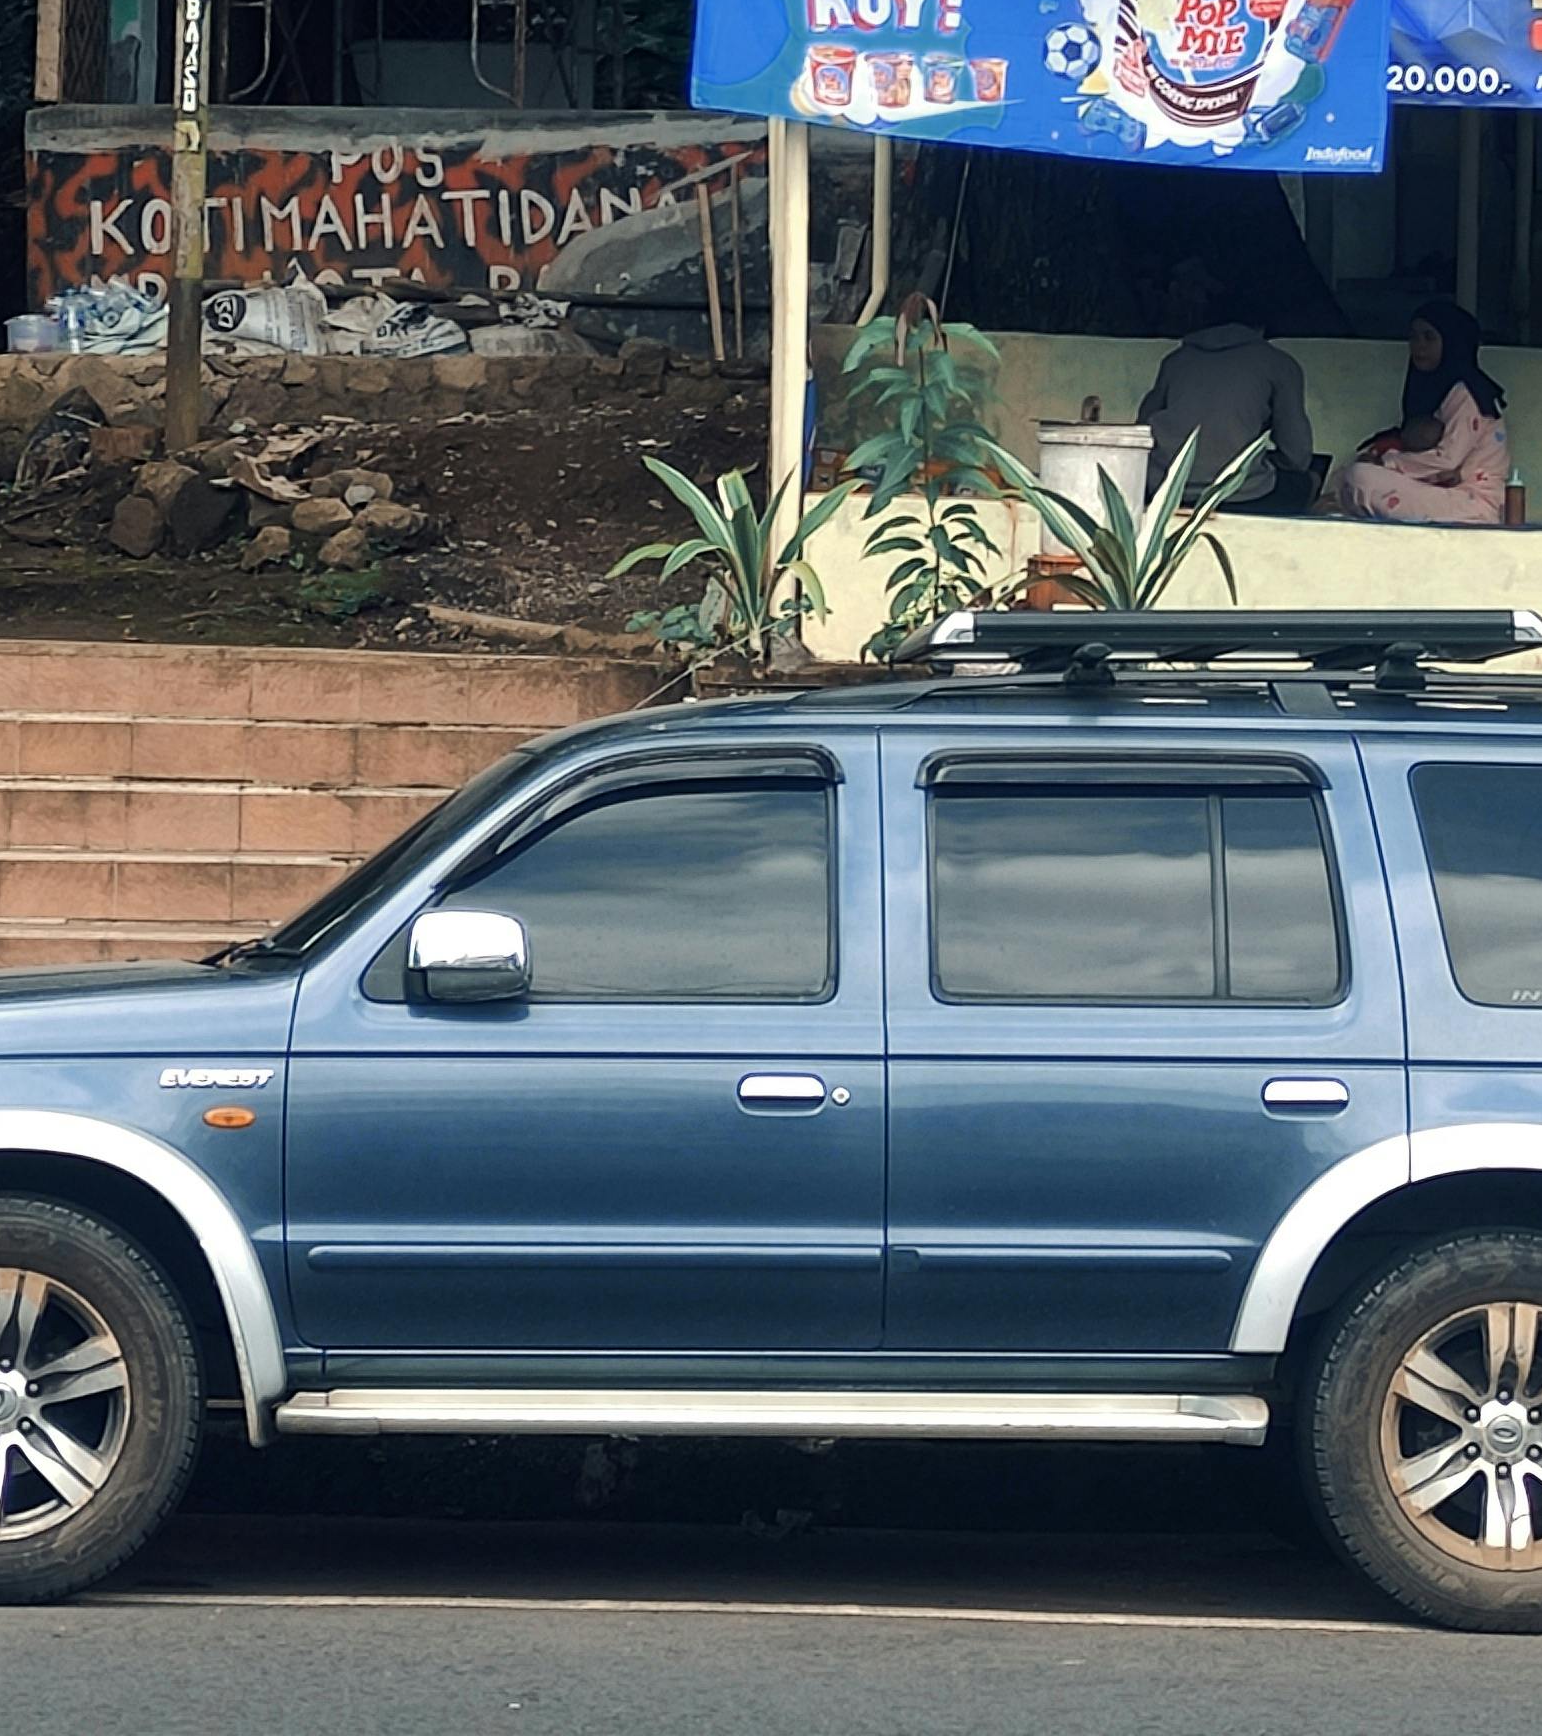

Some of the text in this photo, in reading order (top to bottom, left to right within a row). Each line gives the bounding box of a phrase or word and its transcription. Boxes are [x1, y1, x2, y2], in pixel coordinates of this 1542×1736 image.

[1177, 26, 1245, 56] MIE
[329, 143, 444, 187] POS
[1305, 144, 1373, 164] Indofood
[159, 1068, 275, 1088] EVEREST
